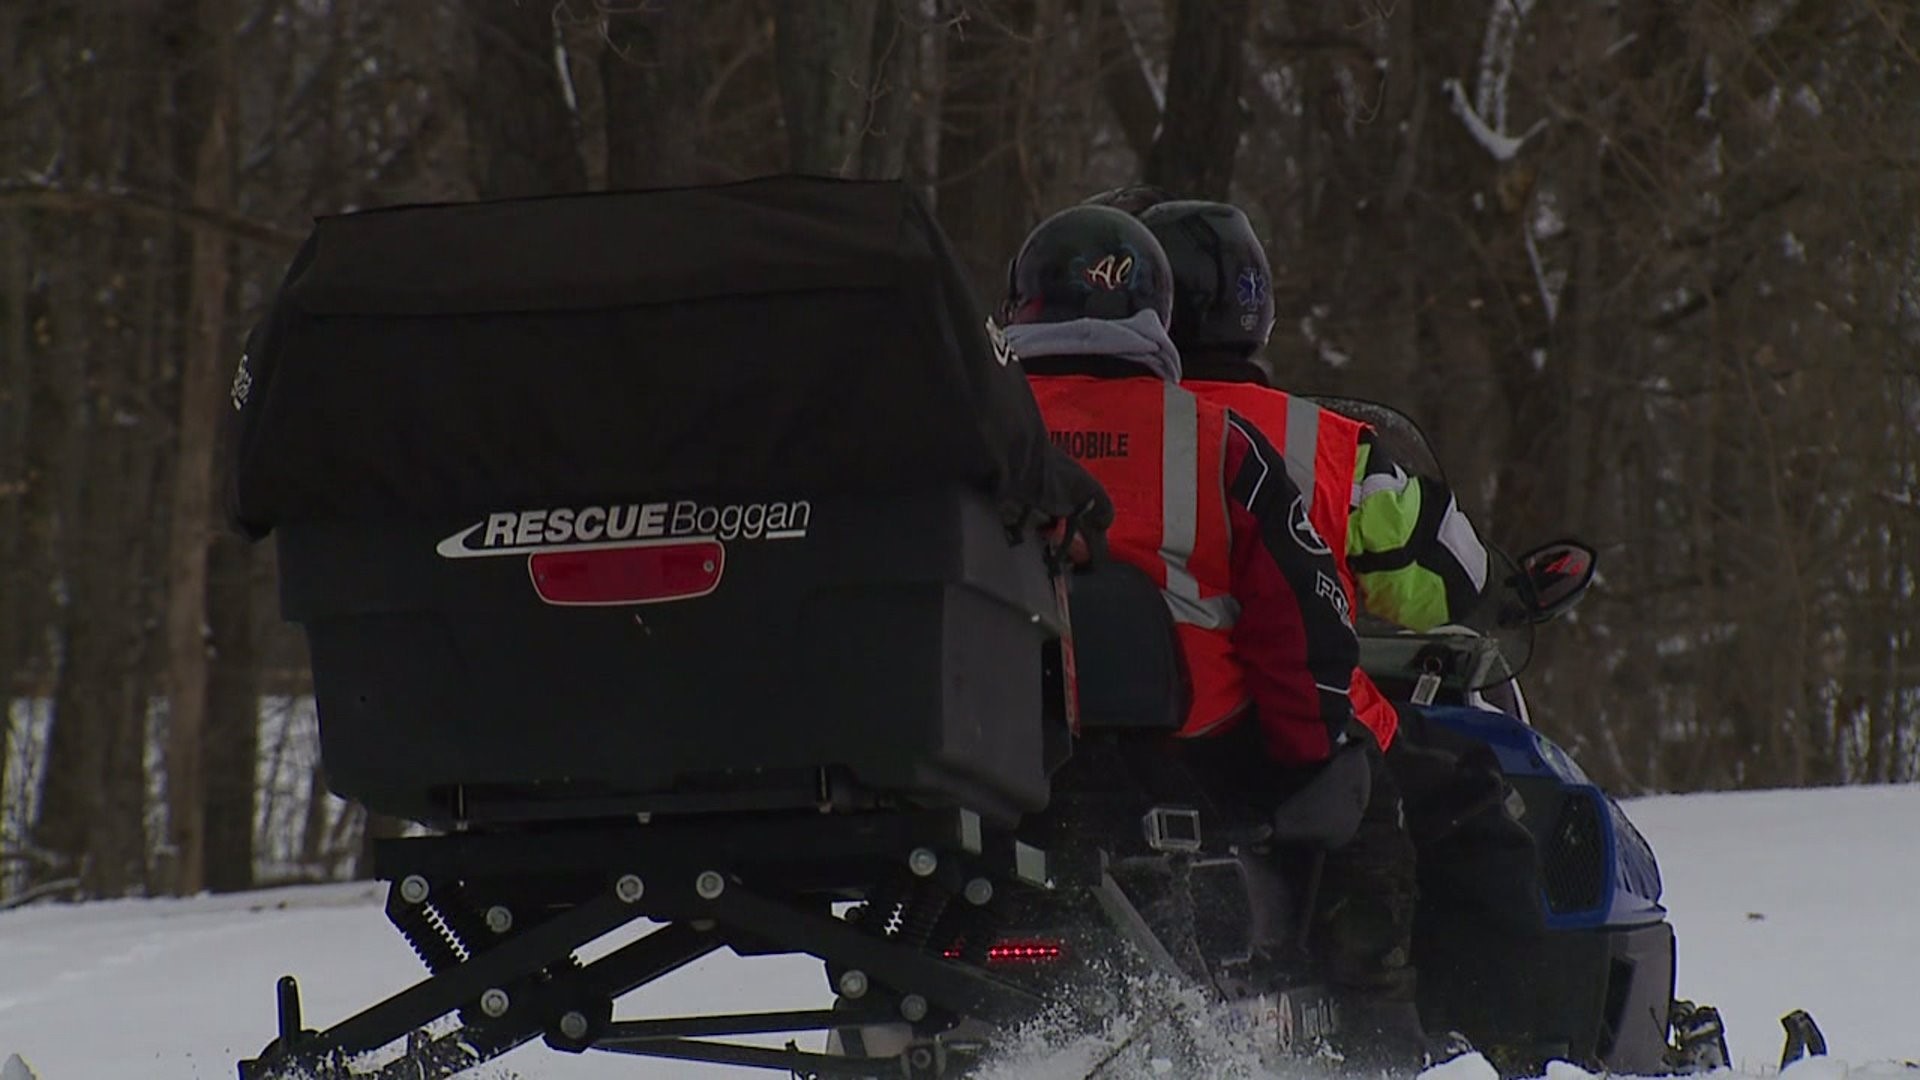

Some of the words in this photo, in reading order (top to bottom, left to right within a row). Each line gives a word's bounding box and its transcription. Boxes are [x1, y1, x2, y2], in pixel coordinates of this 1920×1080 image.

[1050, 431, 1129, 459] MOBILE
[484, 501, 668, 548] RESCUE
[669, 498, 811, 541] Boggan
